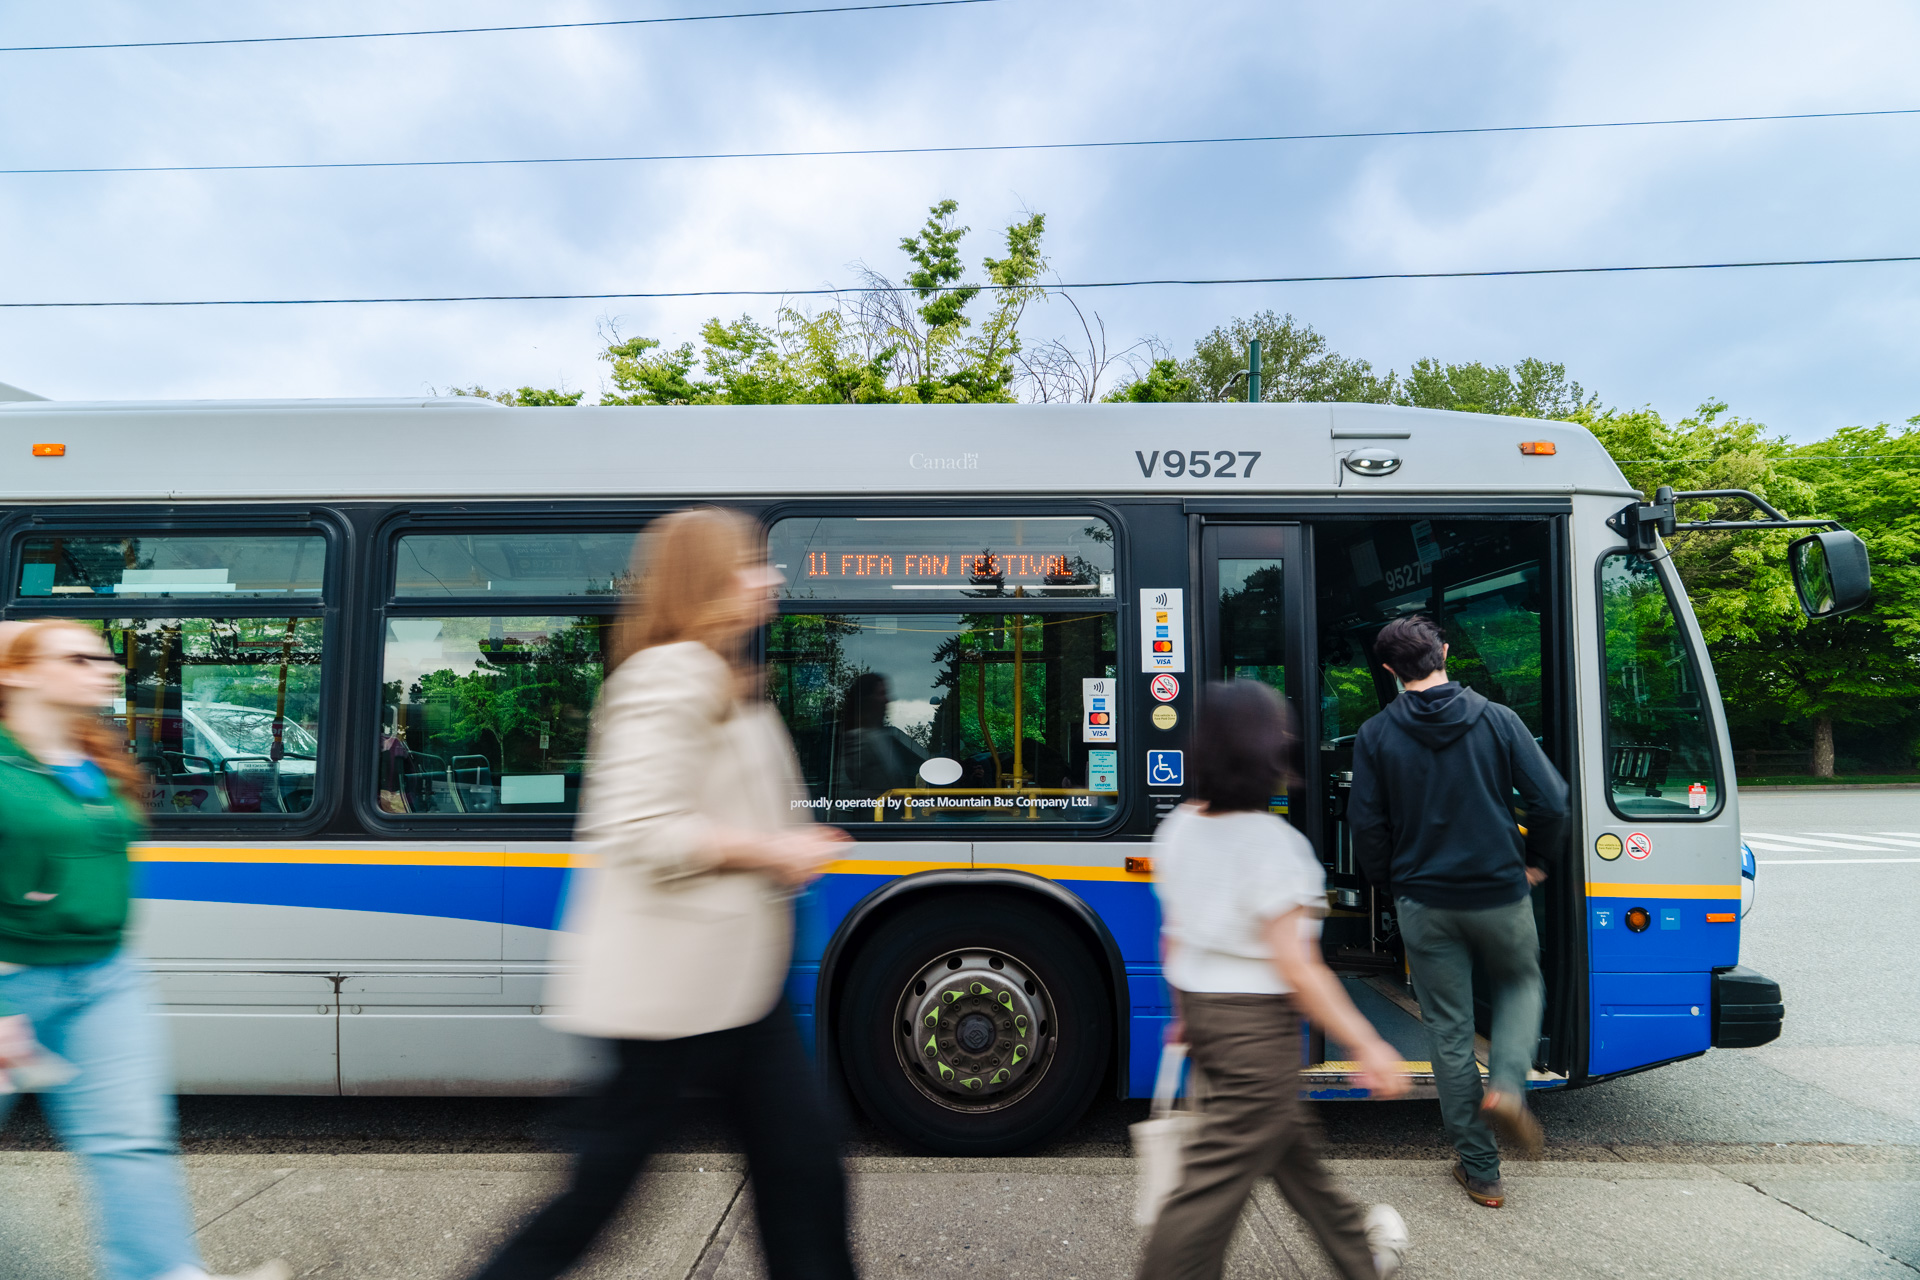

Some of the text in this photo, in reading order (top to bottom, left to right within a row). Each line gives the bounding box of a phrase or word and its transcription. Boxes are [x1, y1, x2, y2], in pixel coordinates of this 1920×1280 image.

[909, 452, 979, 470] Canada
[1135, 450, 1262, 478] V9527
[809, 552, 1073, 576] 11 FIFA FAN FESTIVAL
[1385, 561, 1421, 592] 9527
[790, 796, 1092, 810] proudly operated by Coast Mountain Bus Company Ltd.
